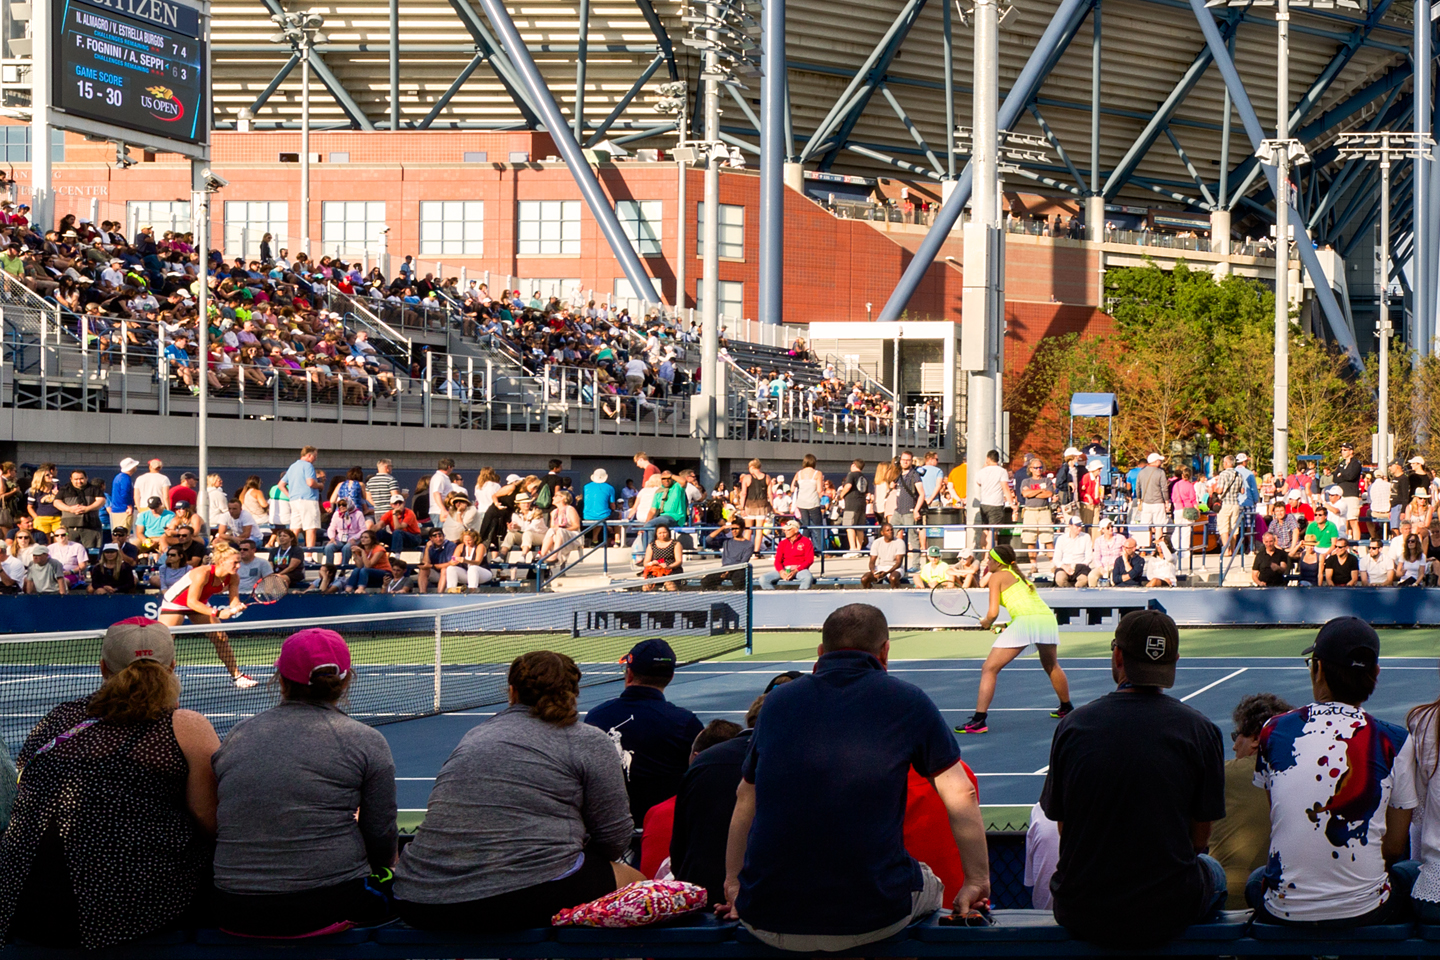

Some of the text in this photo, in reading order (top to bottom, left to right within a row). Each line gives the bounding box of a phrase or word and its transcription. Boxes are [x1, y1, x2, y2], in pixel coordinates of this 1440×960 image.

[83, 13, 109, 31] ALMAGRO
[118, 24, 143, 42] ESTRELLA
[144, 31, 164, 49] BURGOS
[76, 35, 85, 48] F.
[87, 38, 122, 59] FOGNINI
[129, 51, 138, 64] A.
[140, 54, 164, 71] SEPPI
[172, 44, 187, 58] 7 4
[75, 65, 123, 87] GAME SCORE
[172, 66, 187, 80] 6 3
[77, 80, 93, 99] 15
[106, 87, 122, 107] 30
[141, 95, 178, 115] US OPEN
[4, 171, 28, 179] EAN
[59, 185, 108, 196] CENTER
[1149, 639, 1165, 648] LA
[135, 649, 154, 657] NYC
